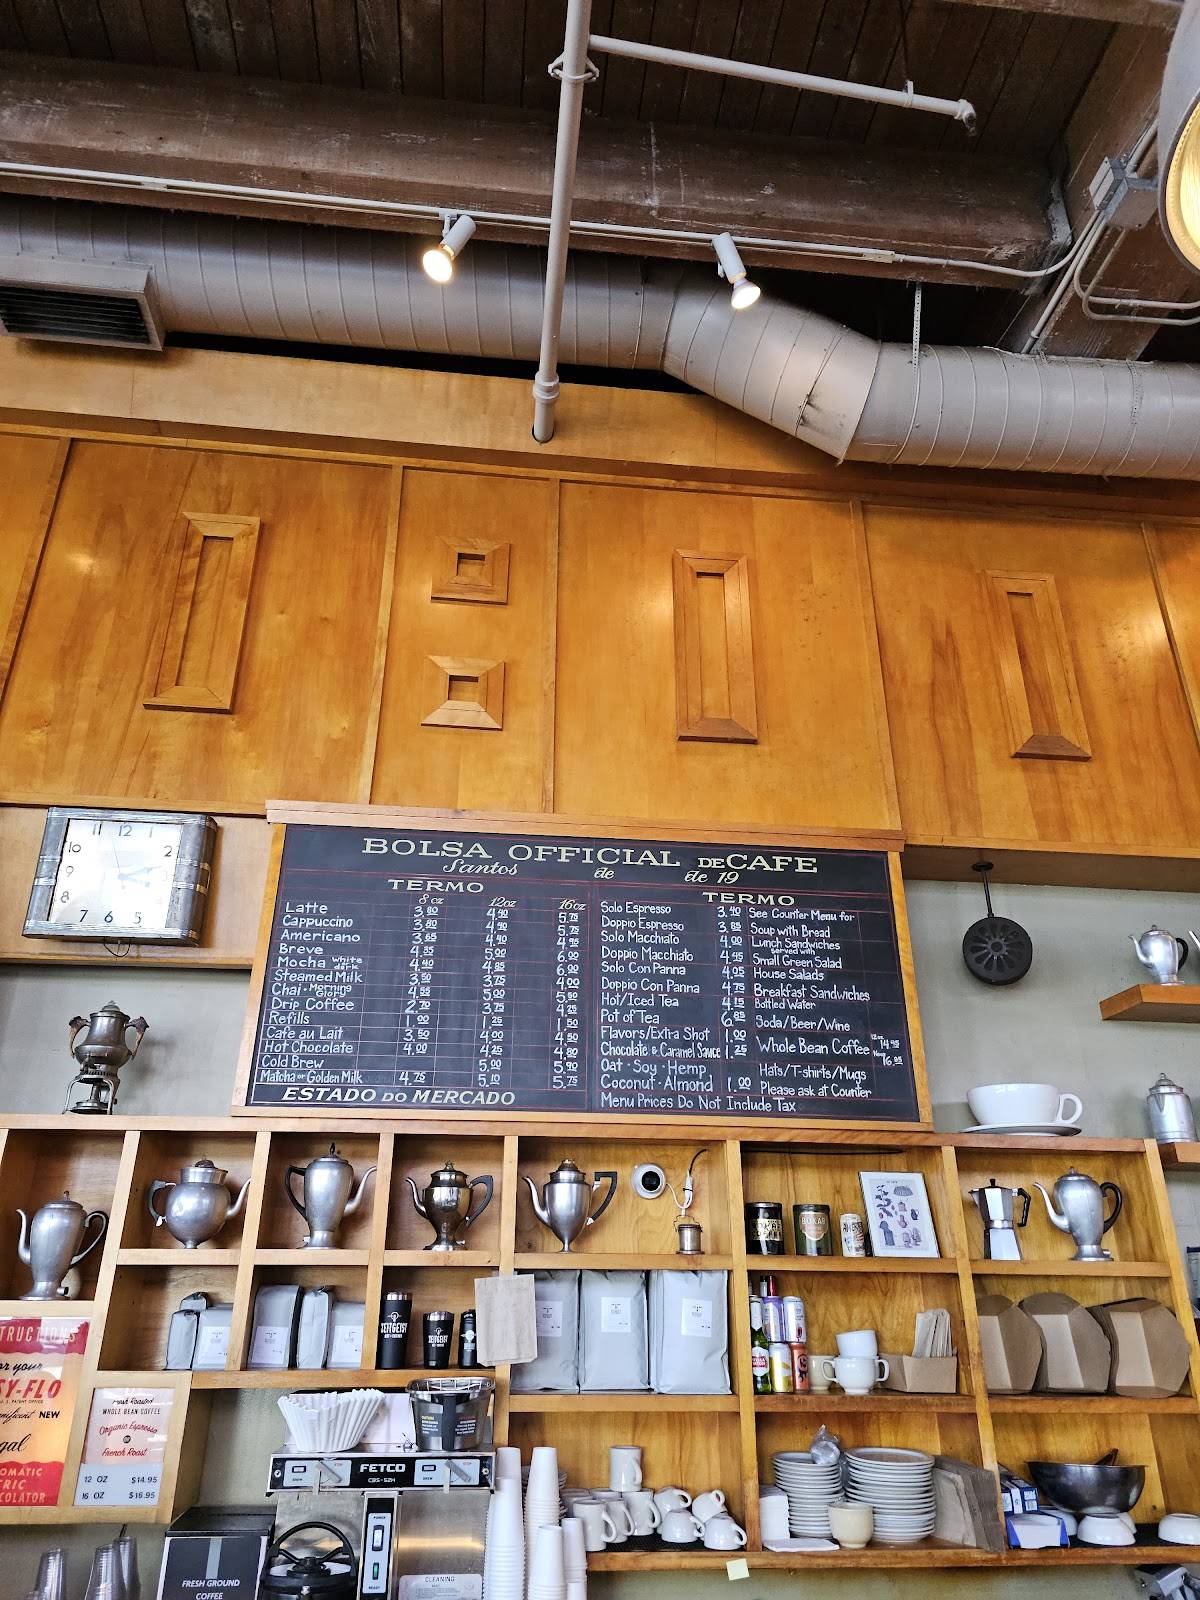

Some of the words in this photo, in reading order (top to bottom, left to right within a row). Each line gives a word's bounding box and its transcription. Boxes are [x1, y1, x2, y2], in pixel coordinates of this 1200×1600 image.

[118, 824, 133, 837] 12
[67, 841, 82, 853] 10
[163, 845, 173, 857] 2
[361, 837, 493, 859] BOLSA
[508, 844, 681, 867] OFFICIAL
[443, 858, 518, 876] Santos
[717, 871, 740, 884] 19
[387, 879, 484, 894] TERMO
[702, 891, 795, 906] TERMO
[285, 902, 328, 914] Latte
[600, 901, 623, 913] Solo
[625, 901, 672, 915] Espresso
[748, 908, 767, 919] See
[771, 908, 809, 920] Counter
[810, 910, 838, 920] Menu
[838, 911, 855, 921] for
[79, 909, 89, 923] 7
[104, 910, 114, 923] 6
[132, 911, 142, 924] 5
[282, 914, 353, 928] Cappuccino
[601, 915, 636, 929] Doppio
[638, 917, 684, 931] Espresso
[280, 929, 361, 943] Americano
[750, 922, 775, 936] Soup
[776, 925, 799, 937] with
[801, 925, 831, 938] Bread
[600, 930, 625, 942] Solo
[627, 930, 680, 945] Macchiato
[751, 936, 782, 948] Lunch
[785, 938, 841, 950] Sandwiches
[279, 943, 324, 955] Breve
[601, 945, 638, 960] Doppio
[641, 946, 694, 962] Macchiato
[277, 956, 326, 968] Mocha
[752, 953, 780, 966] Small
[782, 955, 813, 967] Green
[814, 956, 843, 969] Salad
[601, 962, 625, 973] Solo
[628, 962, 650, 974] Con
[653, 963, 686, 975] Panna
[753, 967, 786, 979] House
[788, 969, 825, 981] Salads
[273, 969, 333, 982] Steamed
[334, 971, 363, 983] Milk
[271, 982, 302, 996] Chai
[308, 983, 352, 992] Morning
[601, 976, 638, 991] Doppio
[640, 978, 664, 992] Con
[666, 979, 700, 994] Panna
[753, 983, 807, 999] Breakfast
[810, 985, 870, 1001] Sandwiches
[271, 997, 300, 1011] Drip
[305, 998, 354, 1011] Coffee
[601, 992, 655, 1006] Hot/Iced
[658, 994, 679, 1007] Tea
[754, 999, 785, 1009] Bottled
[788, 1000, 816, 1010] Water
[268, 1012, 310, 1025] Refills
[600, 1008, 620, 1023] Pot
[622, 1009, 635, 1023] of
[635, 1009, 660, 1024] Tea
[755, 1015, 851, 1031] Soda/Beer/Wine
[266, 1026, 295, 1039] Cafe
[298, 1029, 315, 1040] au
[319, 1026, 343, 1040] Lait
[600, 1025, 680, 1040] Flavors/Extra
[683, 1026, 710, 1041] Shot
[264, 1041, 289, 1053] Hot
[291, 1041, 353, 1054] Chocolate
[600, 1041, 647, 1057] Chocolate
[659, 1042, 695, 1058] Caramel
[697, 1043, 721, 1059] Sauce
[756, 1036, 796, 1053] Whole
[798, 1037, 829, 1055] Bean
[832, 1038, 870, 1056] Coffee
[261, 1055, 288, 1068] Cold
[291, 1056, 324, 1068] Brew
[600, 1058, 623, 1072] Oat
[633, 1059, 657, 1076] Soy
[668, 1060, 706, 1078] Hemp
[260, 1070, 296, 1082] Matcha
[306, 1070, 340, 1083] Golden
[341, 1070, 363, 1084] Milk
[759, 1063, 867, 1085] Hats/T-shirts/Mugs
[600, 1075, 655, 1090] Coconut
[663, 1075, 713, 1092] Almond
[760, 1081, 795, 1096] Please
[797, 1085, 815, 1096] ask
[818, 1085, 829, 1097] at
[830, 1084, 872, 1098] Counter
[281, 1086, 377, 1102] ESTADO
[381, 1092, 408, 1103] DO
[411, 1089, 516, 1105] MERCADO
[601, 1092, 635, 1108] Menu
[637, 1094, 673, 1108] Prices
[678, 1096, 693, 1109] Do
[698, 1096, 722, 1109] Not
[726, 1096, 772, 1112] Include
[773, 1097, 796, 1112] Tax
[39, 1410, 60, 1419] NEW
[140, 1407, 161, 1415] COFFEE
[99, 1423, 128, 1436] Organic
[128, 1421, 158, 1434] Espresso
[102, 1447, 126, 1457] French
[126, 1447, 148, 1457] Roast
[359, 1463, 406, 1473] FETCO
[131, 1476, 158, 1484] $14.95
[82, 1492, 89, 1500] 16
[181, 1580, 206, 1588] FRESH
[206, 1579, 241, 1587] GROUND
[195, 1592, 224, 1600] COFFEE
